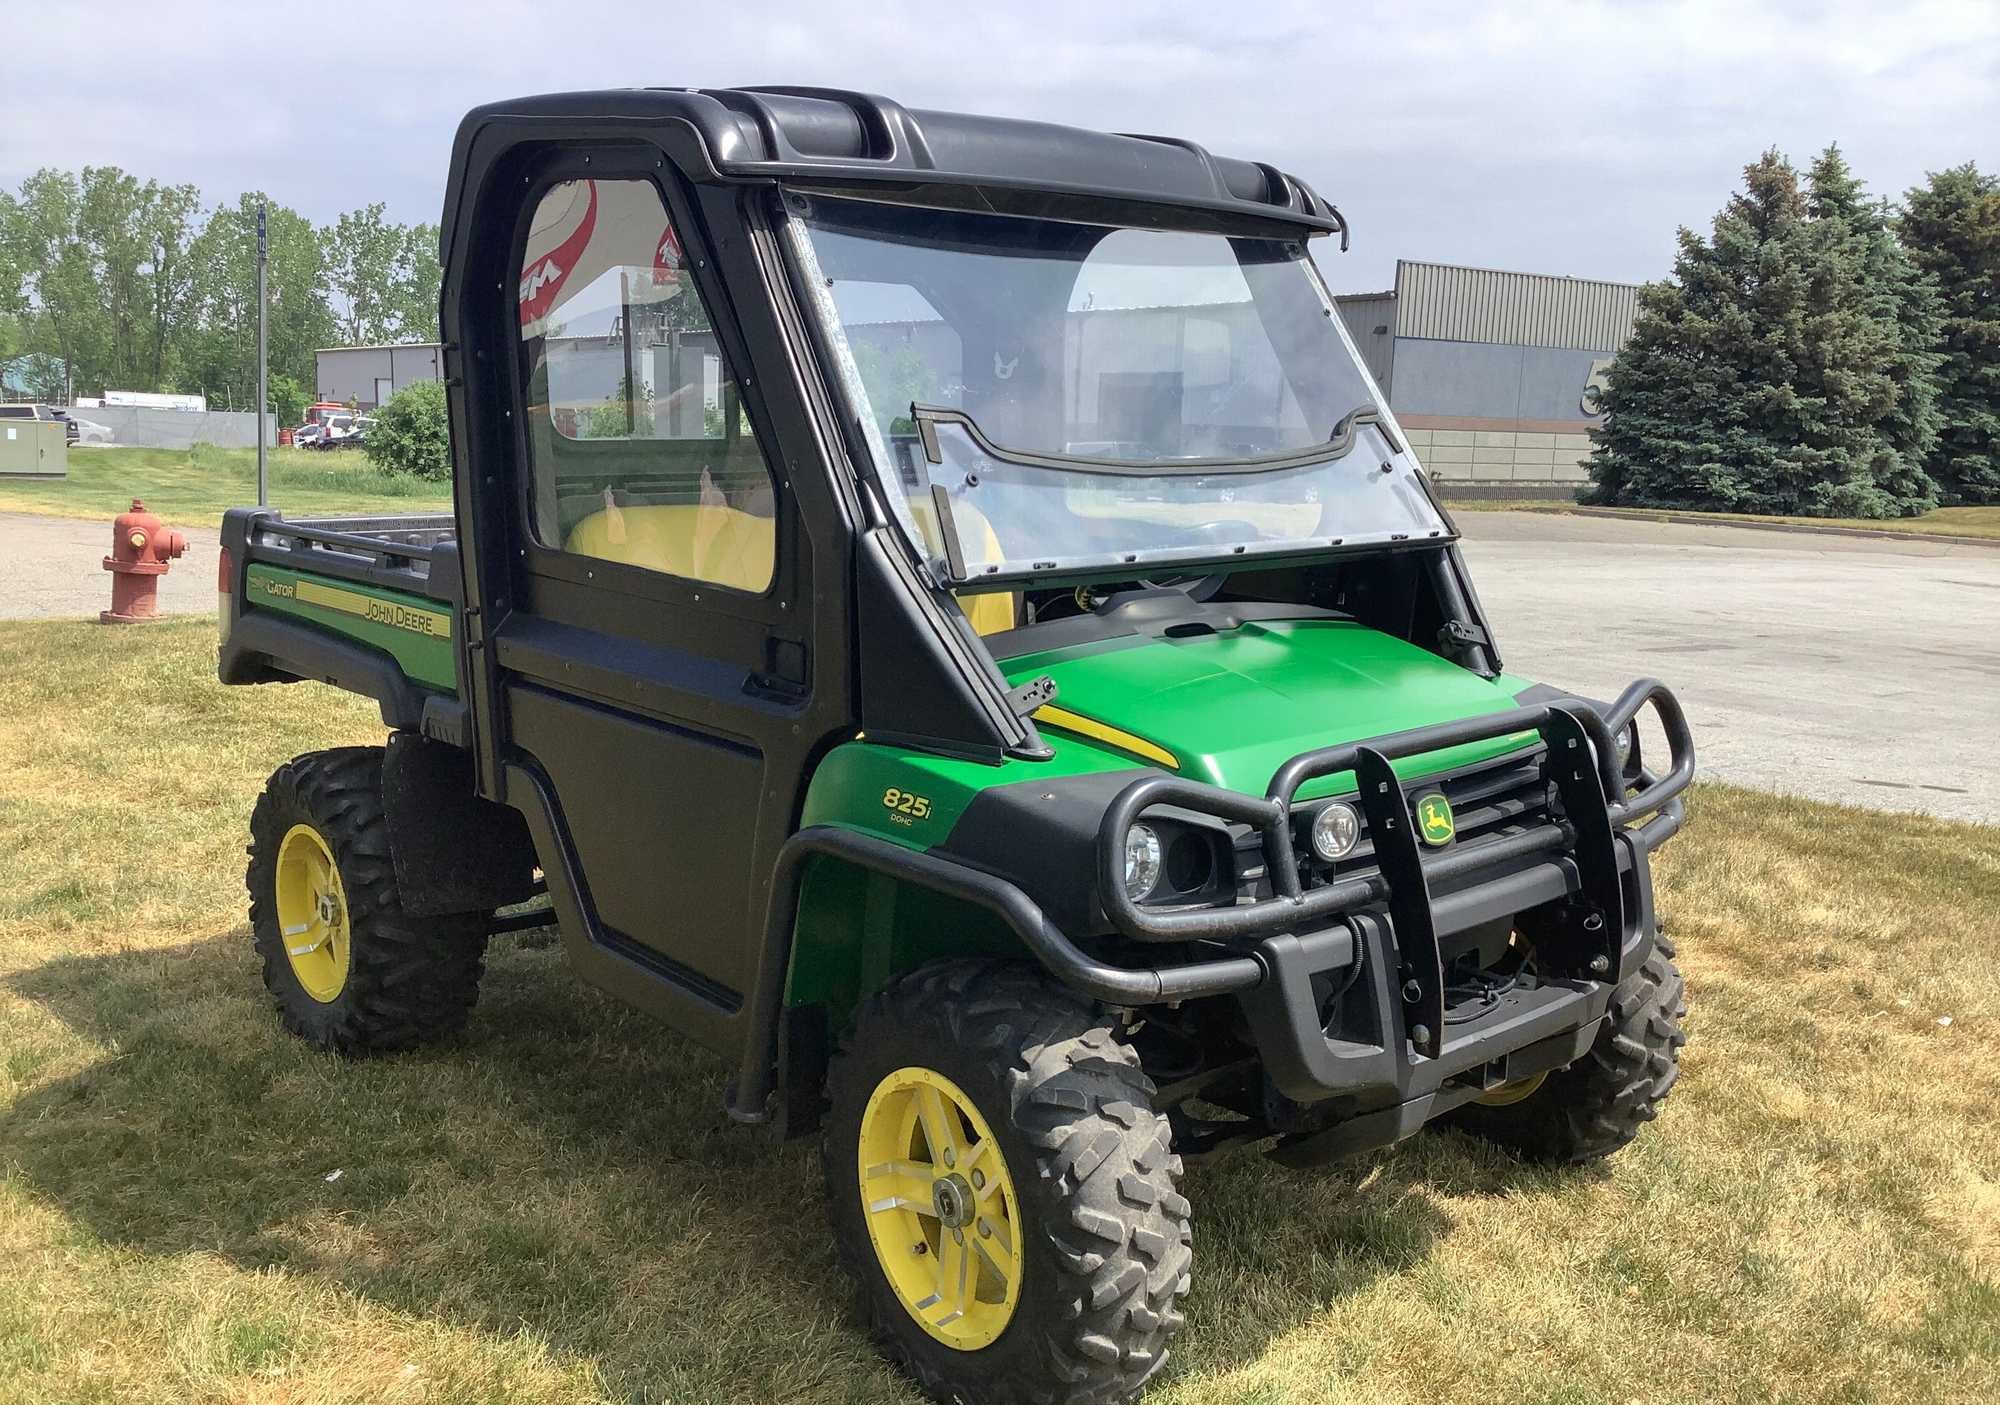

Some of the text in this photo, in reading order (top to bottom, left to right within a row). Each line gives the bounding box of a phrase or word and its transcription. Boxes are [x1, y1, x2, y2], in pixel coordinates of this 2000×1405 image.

[267, 580, 294, 598] GATOR
[364, 599, 432, 633] JOHN DEERE
